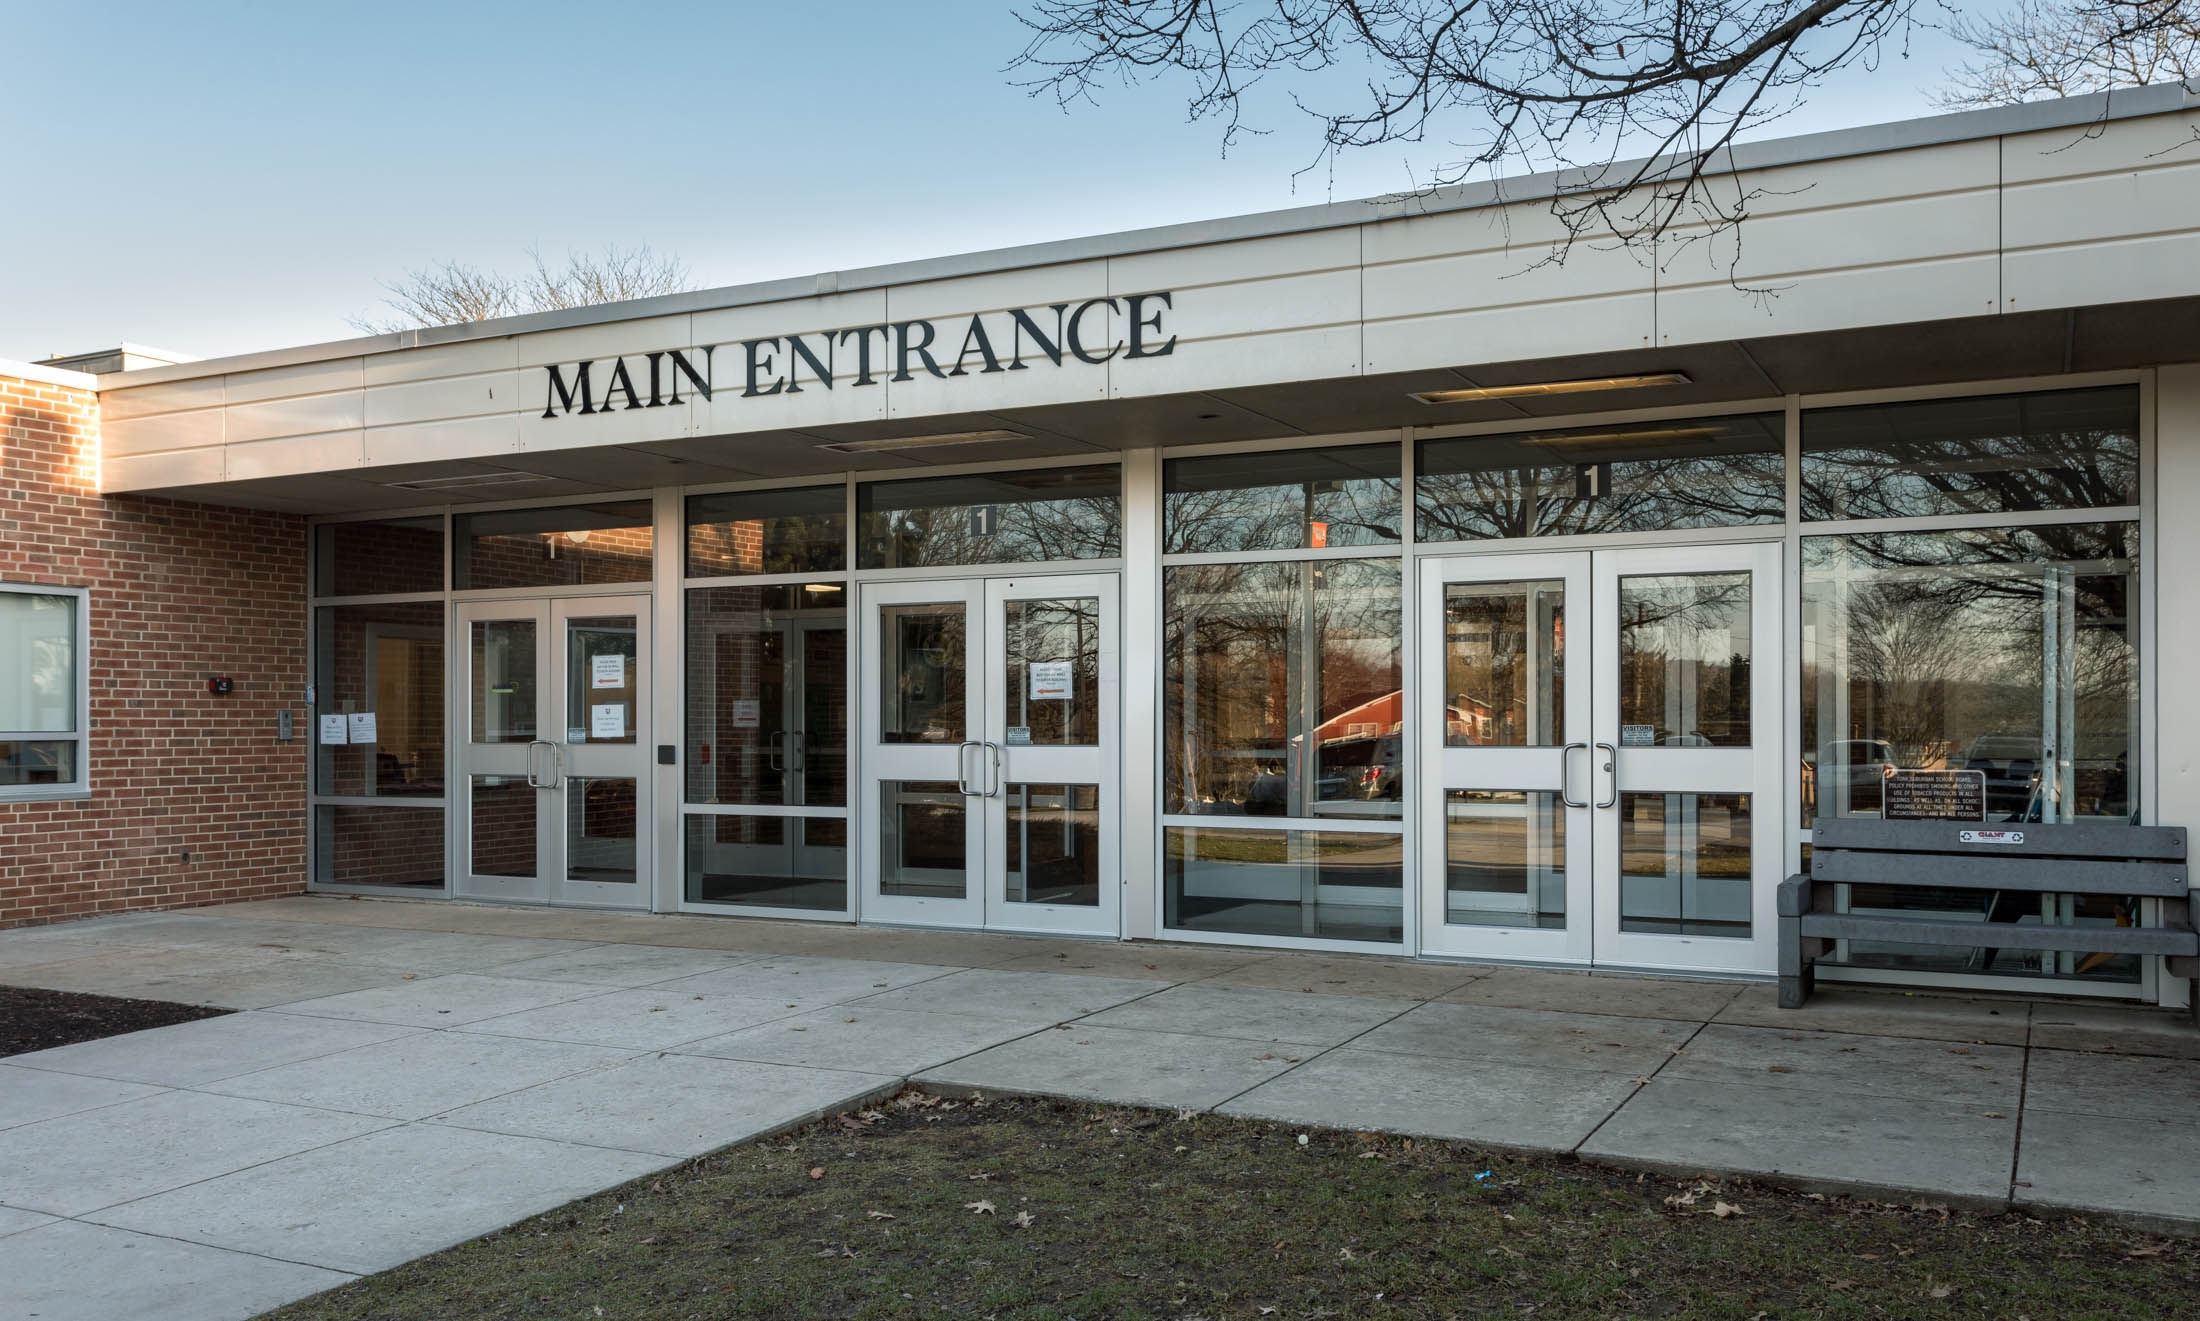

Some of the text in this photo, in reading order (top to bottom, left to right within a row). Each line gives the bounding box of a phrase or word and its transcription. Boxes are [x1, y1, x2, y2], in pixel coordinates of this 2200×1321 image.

[542, 291, 1177, 418] MAIN ENTRANCE
[1584, 464, 1598, 496] 1
[976, 507, 987, 535] 1
